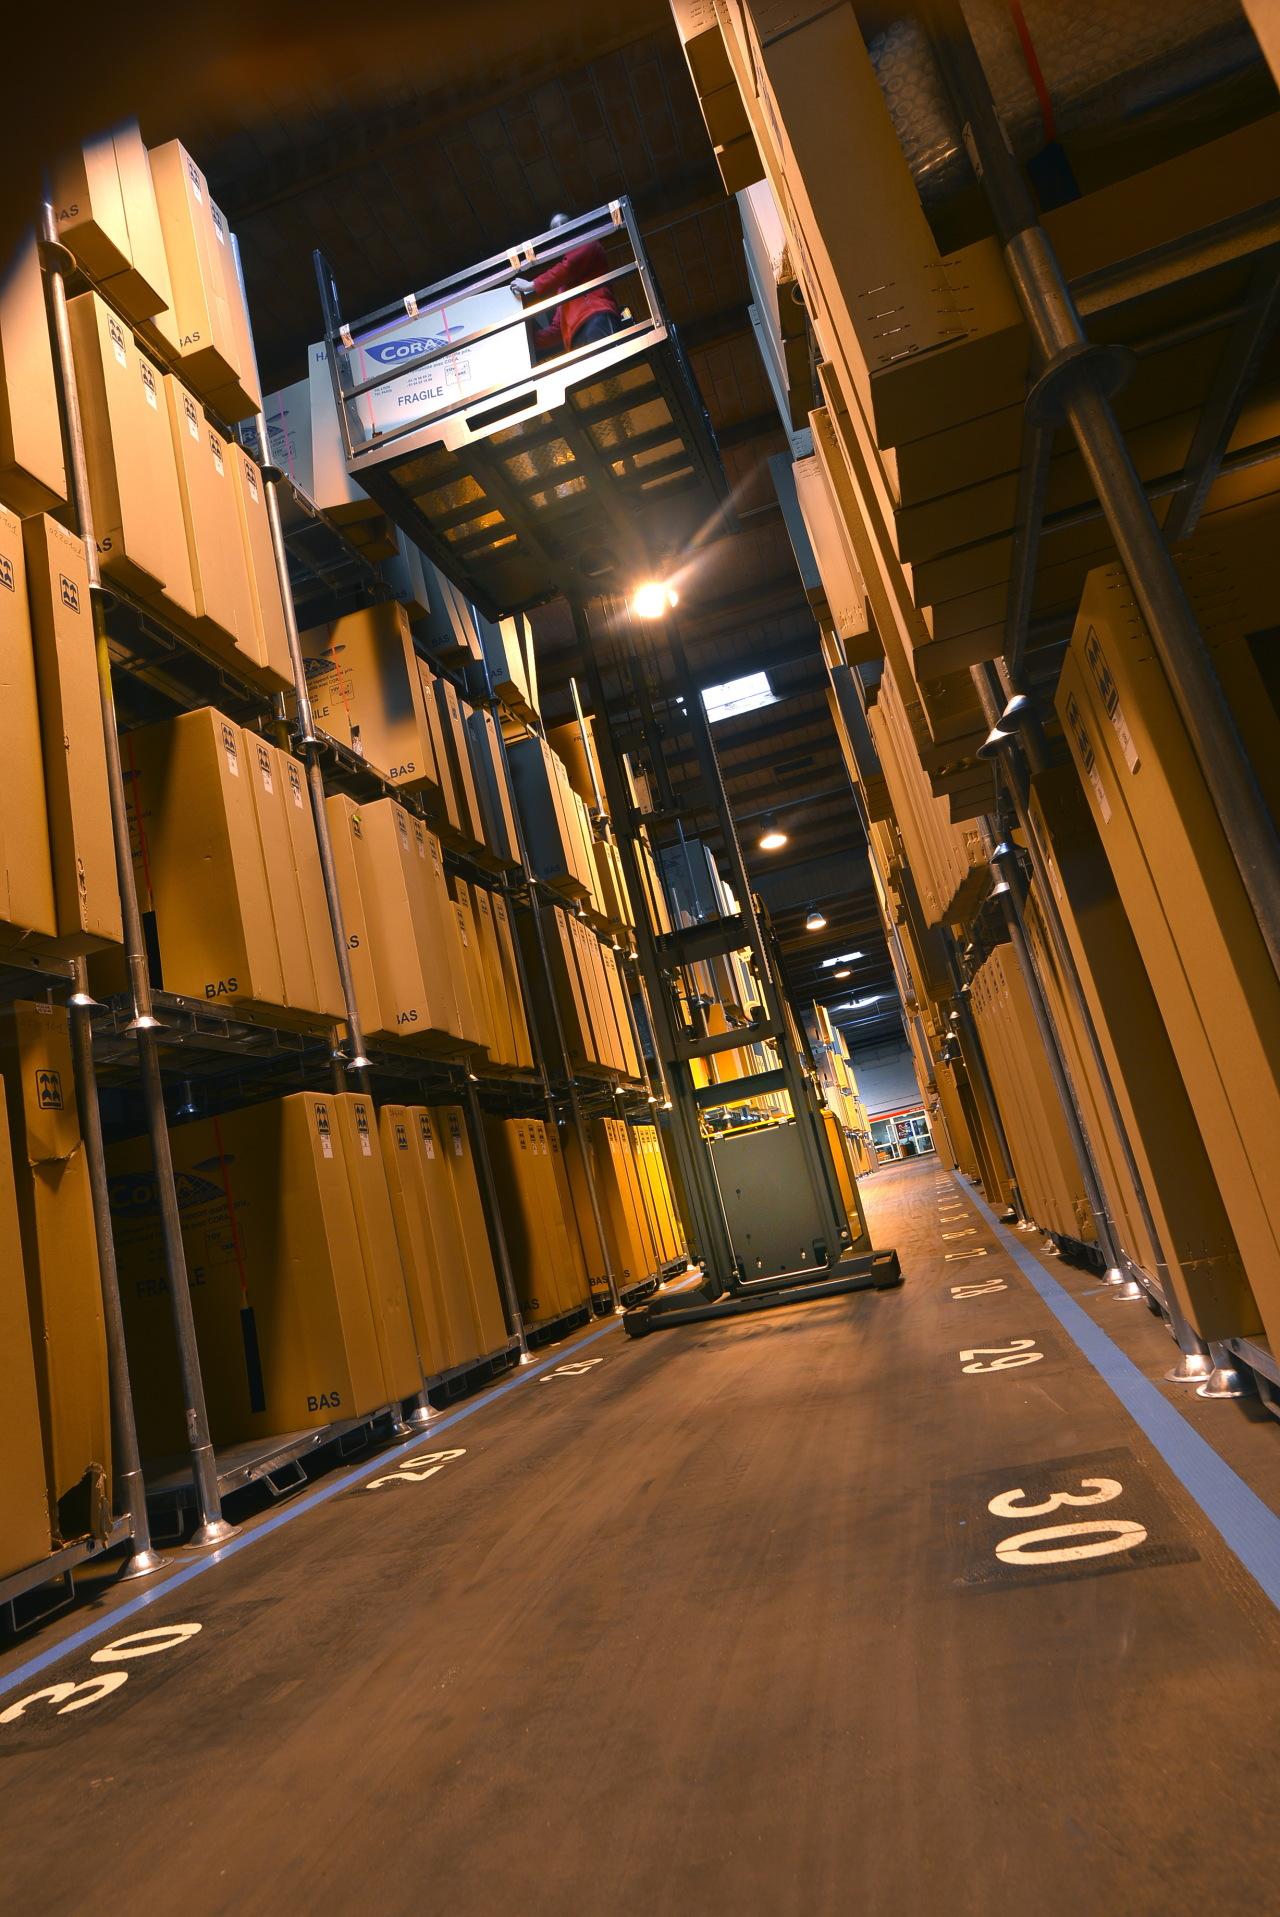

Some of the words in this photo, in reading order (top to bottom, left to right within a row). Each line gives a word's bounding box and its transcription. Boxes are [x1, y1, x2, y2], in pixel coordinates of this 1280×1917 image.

[56, 204, 79, 222] AS
[397, 386, 444, 407] FRAGILE
[390, 763, 416, 779] BAS
[205, 977, 238, 999] BAS
[950, 1279, 1009, 1300] 28
[959, 1339, 1044, 1374] 29
[539, 1358, 604, 1382] 28
[307, 1391, 341, 1412] BAS
[365, 1448, 467, 1489] 29
[987, 1478, 1148, 1565] 30
[0, 1622, 202, 1724] 30
